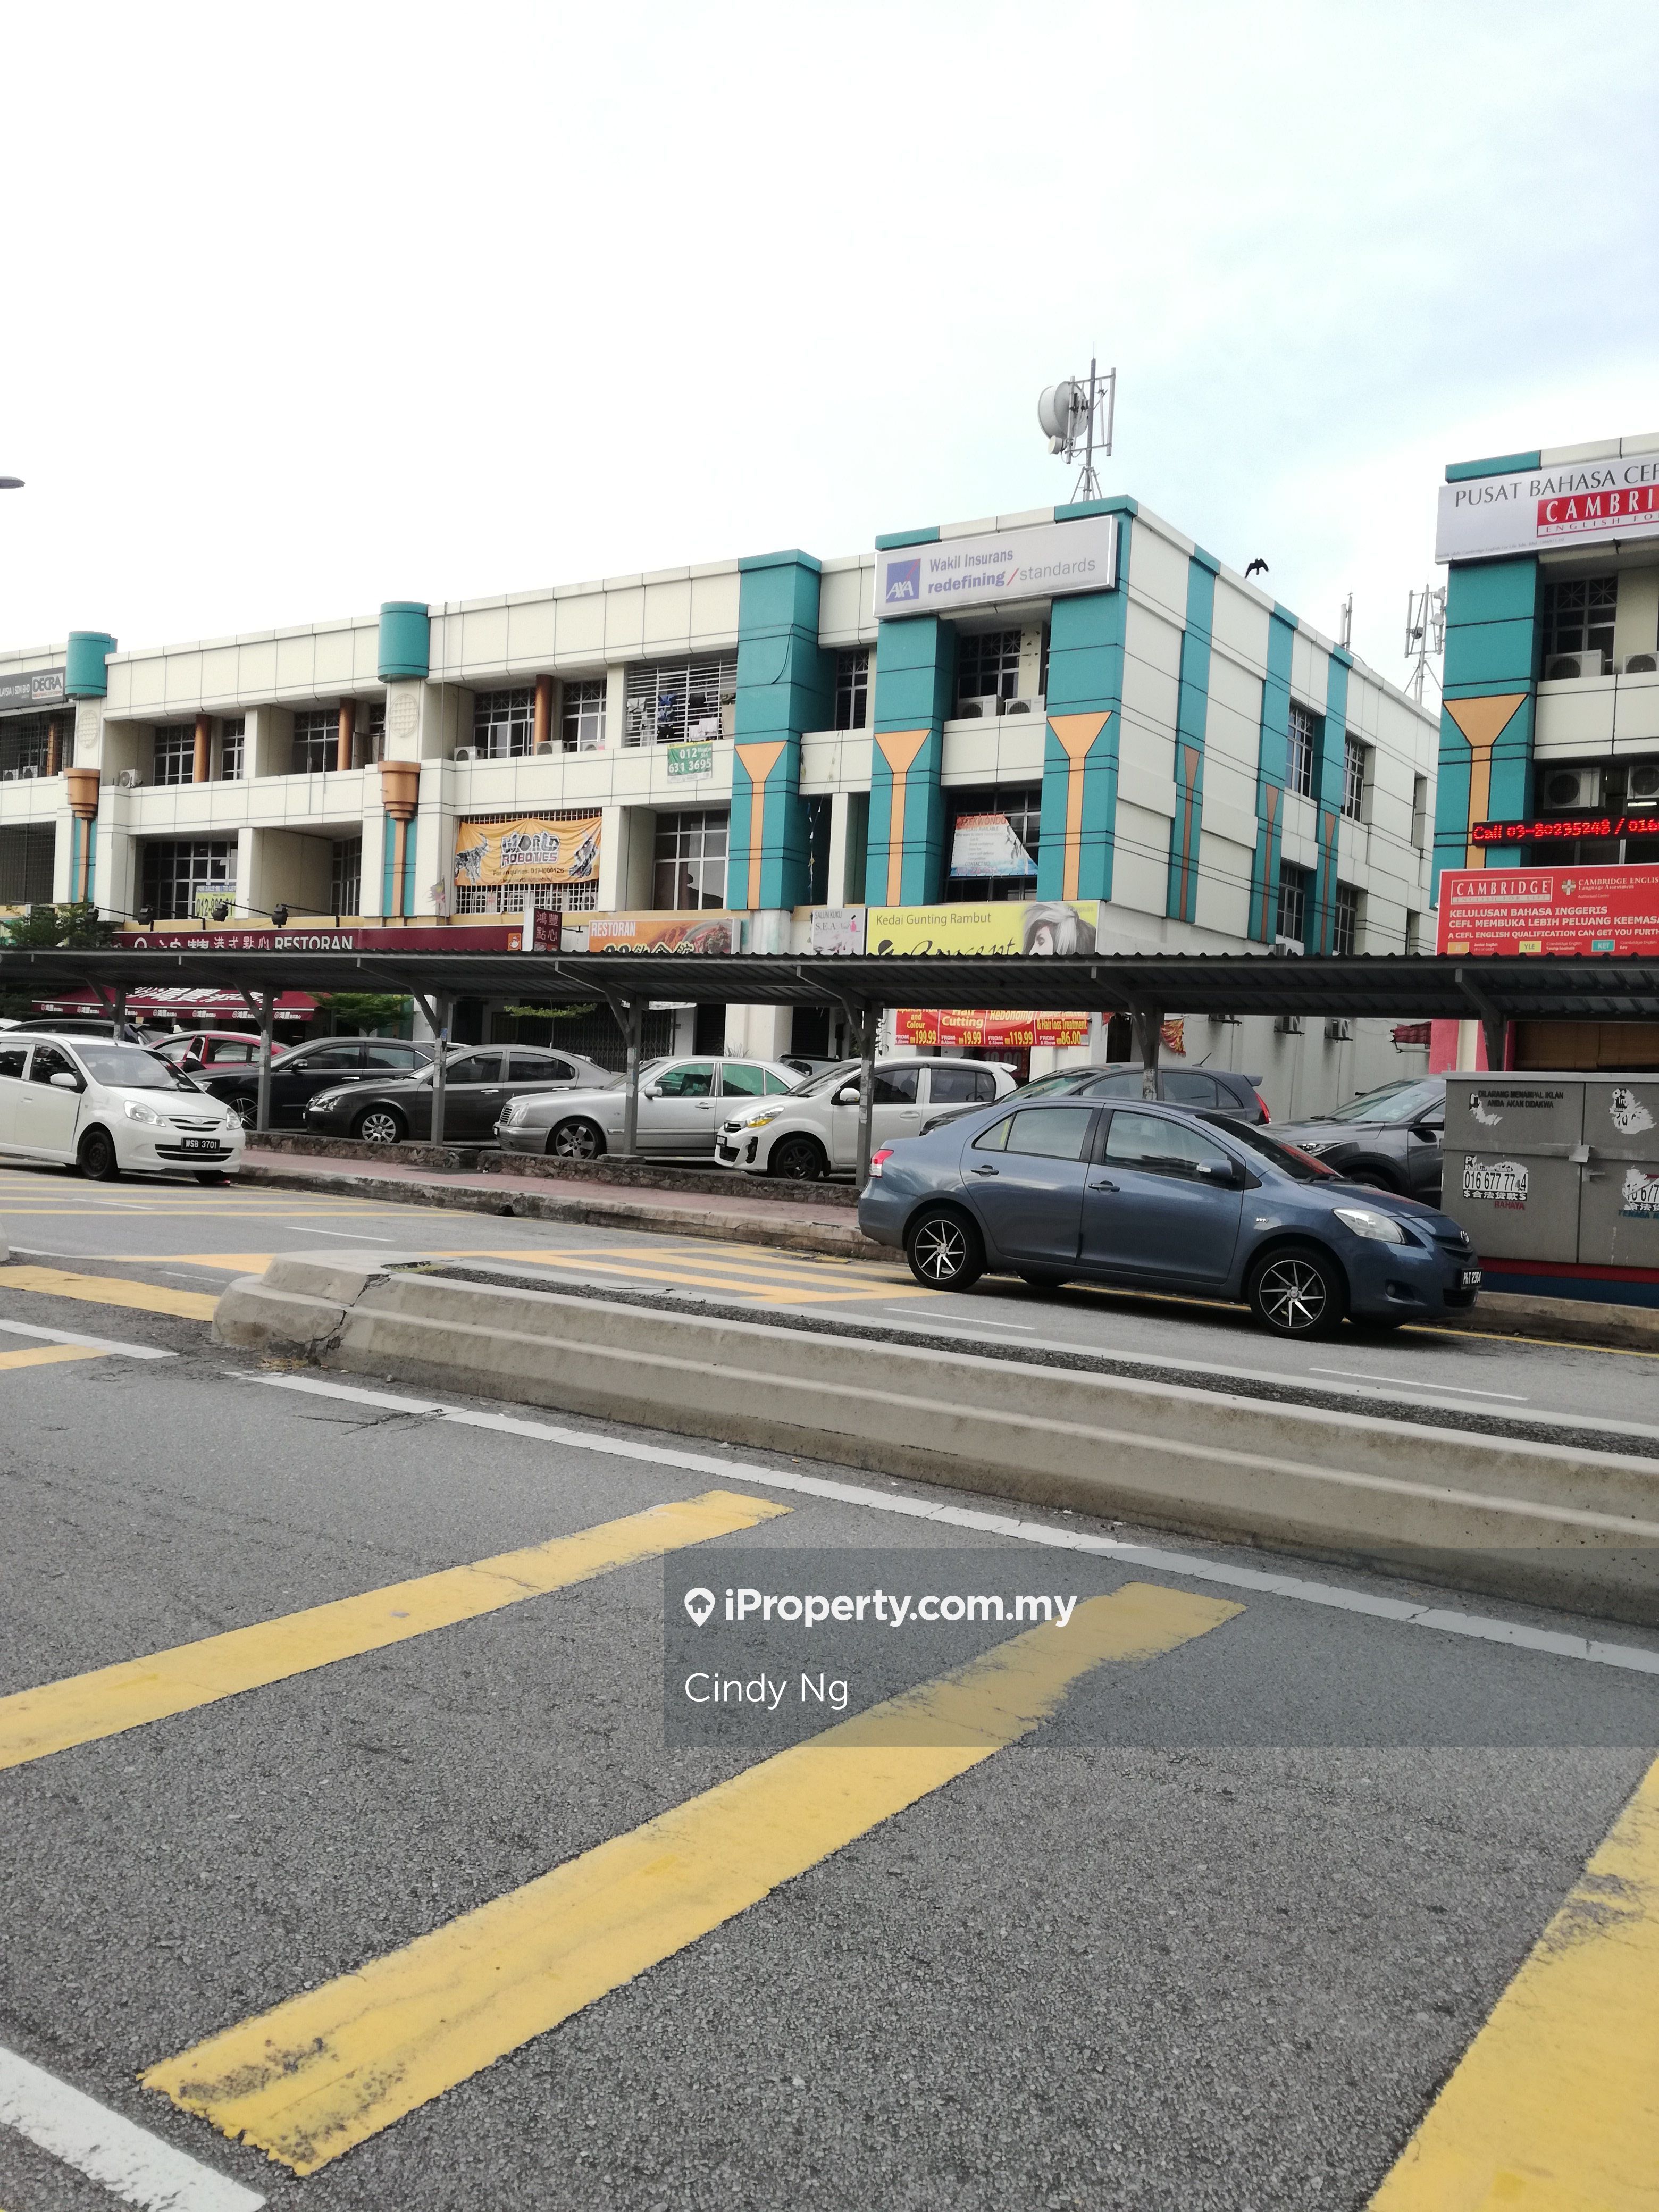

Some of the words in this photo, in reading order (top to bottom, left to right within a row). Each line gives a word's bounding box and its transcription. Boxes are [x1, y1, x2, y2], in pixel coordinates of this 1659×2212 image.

[1455, 482, 1523, 507] PUSAT
[1530, 470, 1616, 497] BAHASA
[1546, 517, 1620, 532] ENGLISH
[1633, 512, 1659, 522] FO
[929, 556, 961, 573] Wakil
[965, 550, 1013, 567] Insurans
[886, 580, 914, 600] AXA
[32, 675, 62, 692] DECRA
[680, 747, 697, 759] 012
[668, 762, 685, 773] 631
[688, 758, 711, 771] 3695
[1473, 825, 1503, 839] Call
[1628, 819, 1659, 833] 016
[1456, 880, 1548, 896] CAMBRIDGE
[876, 914, 903, 925] Kedai
[906, 913, 948, 927] Gunting
[950, 912, 991, 924] Rambut
[1449, 909, 1507, 918] KELULUSAN
[1511, 908, 1552, 916] BAHASA
[1555, 906, 1608, 915] INGGERIS
[591, 921, 636, 937] RESTORAN
[1475, 919, 1525, 927] MEMBUKA
[1528, 918, 1559, 926] LEBIH
[1562, 917, 1611, 925] PELUANG
[535, 926, 558, 941] 點心
[1512, 930, 1576, 939] QUALIFICATION
[275, 935, 353, 949] RESTORAN
[942, 1016, 984, 1029] Cutting
[1041, 1019, 1052, 1030] Hair
[1052, 1019, 1062, 1029] loss
[1062, 1018, 1087, 1030] Treatment
[186, 1139, 199, 1148] WSB
[202, 1140, 217, 1149] 3701
[1464, 1171, 1481, 1189] 016
[1484, 1172, 1501, 1190] 677
[1504, 1173, 1527, 1192] 774
[1494, 1201, 1524, 1210] BAHAYA
